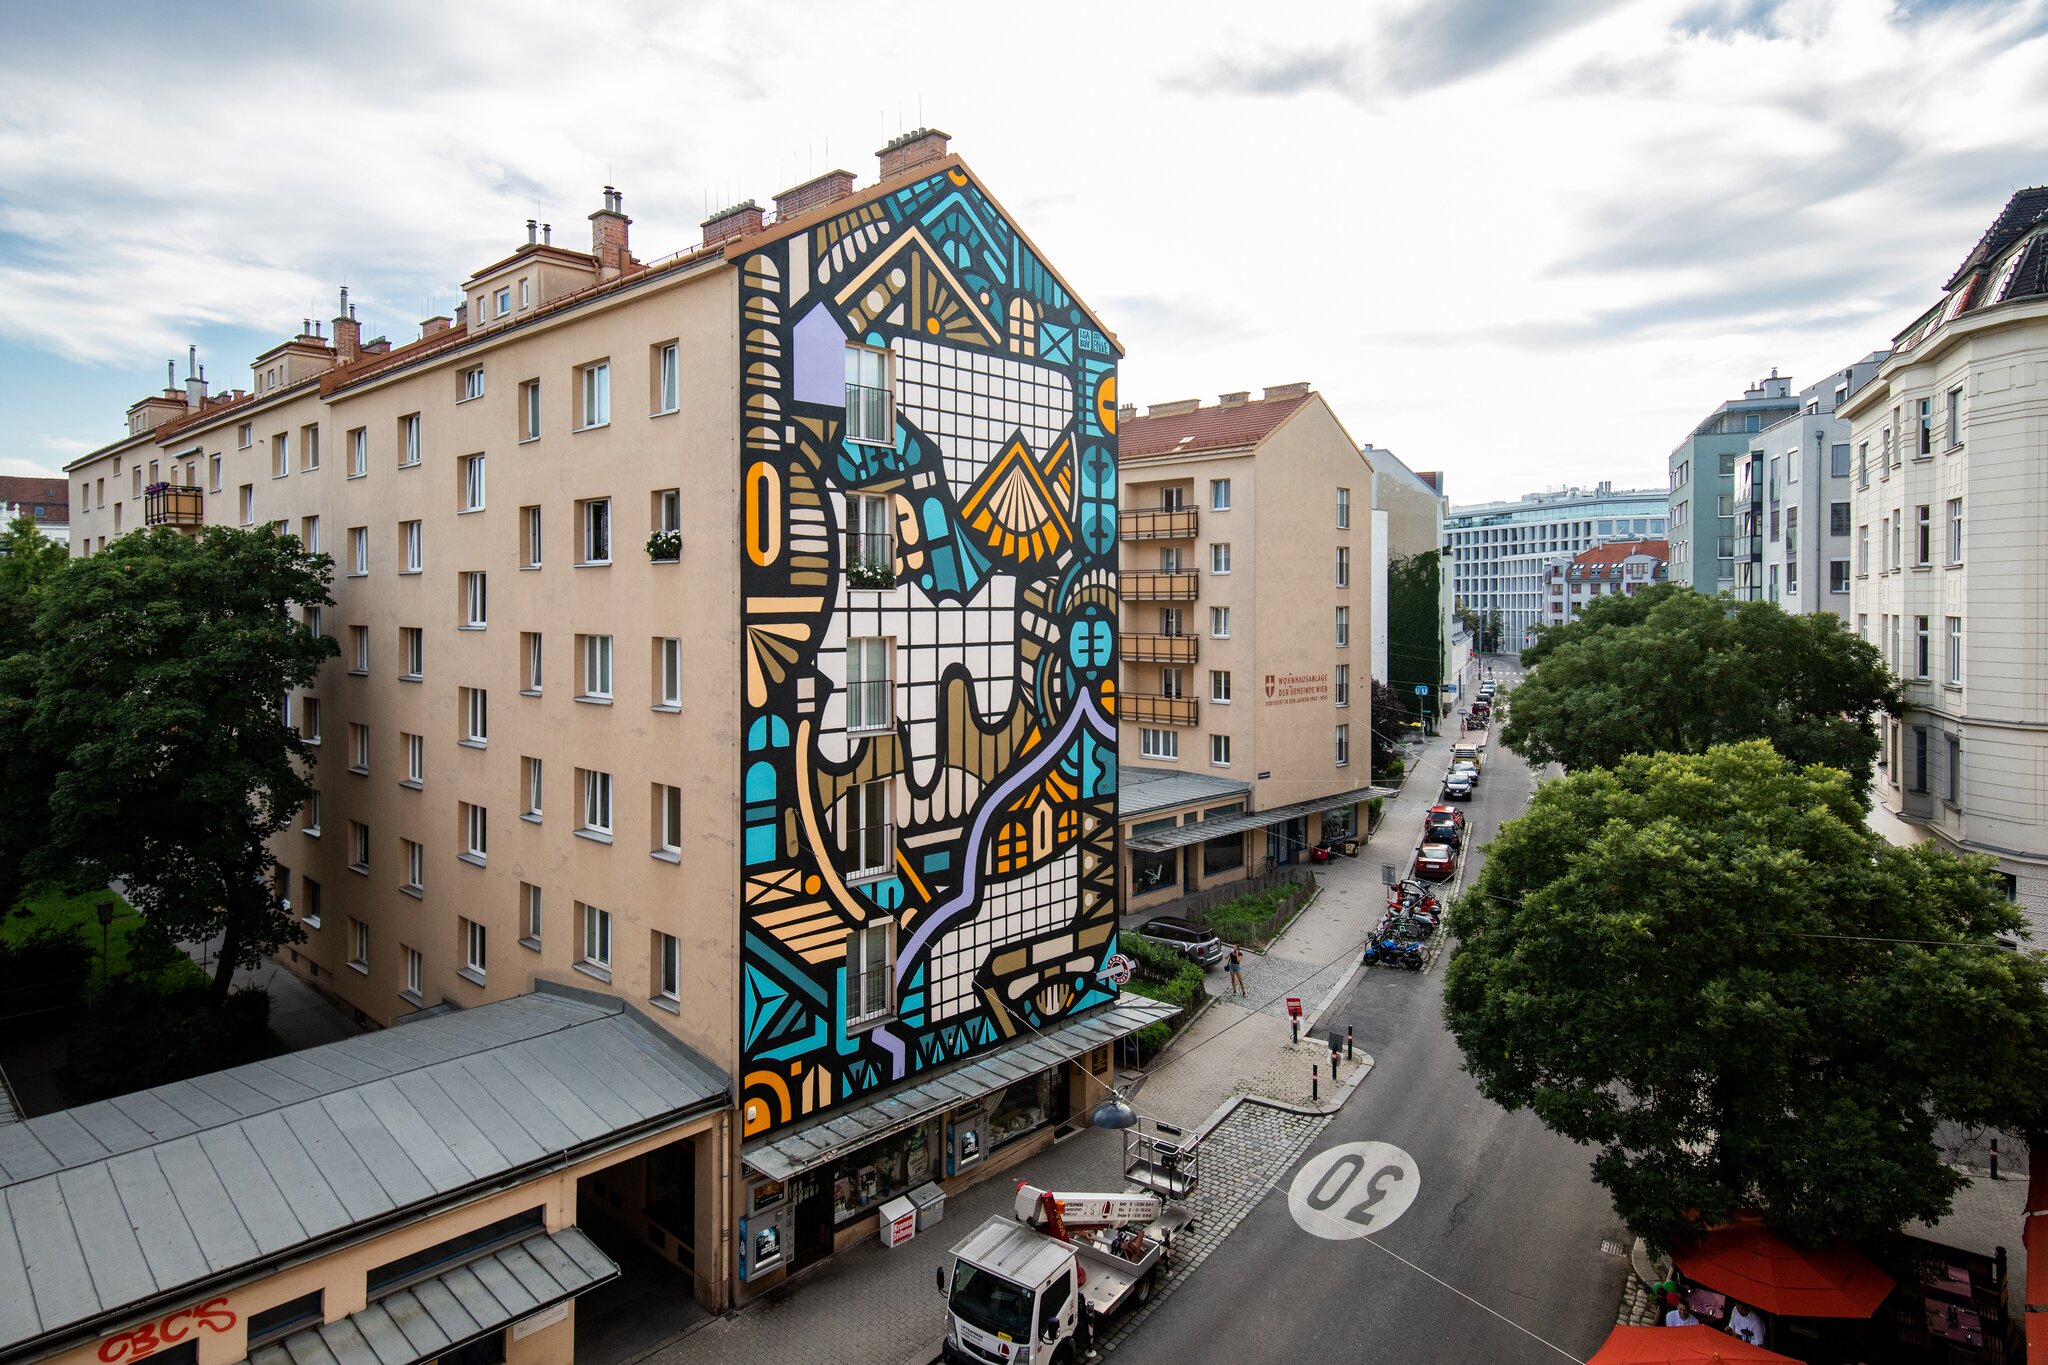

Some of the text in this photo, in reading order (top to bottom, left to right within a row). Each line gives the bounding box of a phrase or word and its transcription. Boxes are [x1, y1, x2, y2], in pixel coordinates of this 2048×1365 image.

[1278, 674, 1328, 684] WOHNHAUSANLAGE
[1278, 685, 1328, 696] DER GEMEINDE WIEN
[1307, 1153, 1404, 1226] 30
